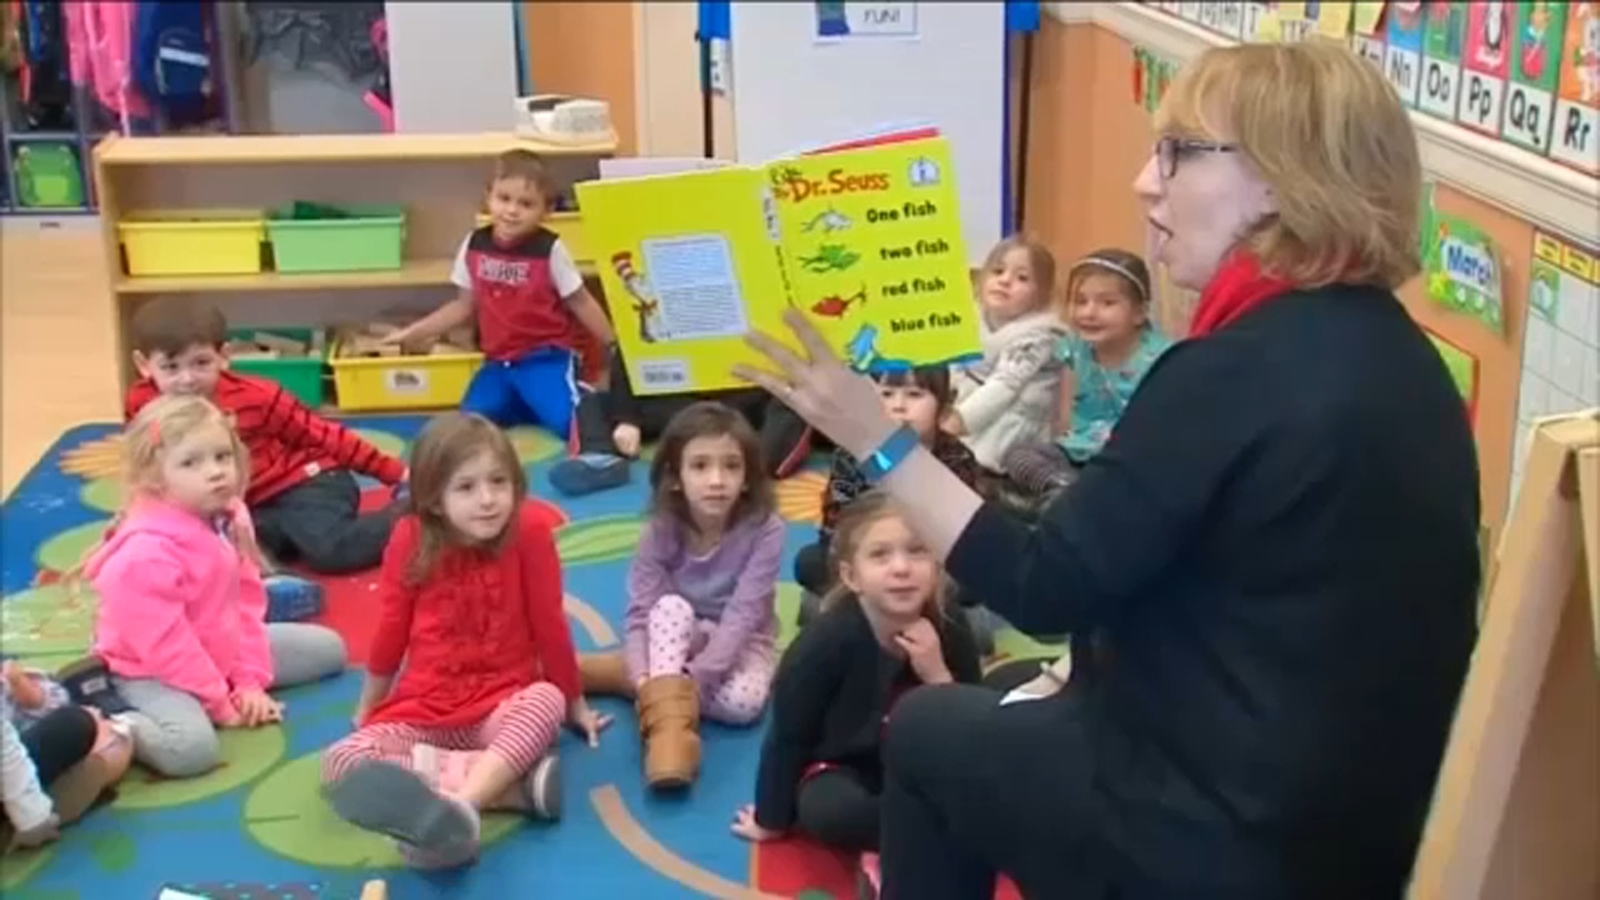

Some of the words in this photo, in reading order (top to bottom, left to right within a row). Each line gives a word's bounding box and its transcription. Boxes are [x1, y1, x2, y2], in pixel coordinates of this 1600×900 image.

[1427, 63, 1450, 101] Oo
[1469, 76, 1491, 123] Pp
[1509, 89, 1541, 145] Qq
[1564, 106, 1591, 151] Rr
[787, 177, 827, 202] Dr.
[828, 169, 891, 194] Seuss
[866, 208, 899, 223] One
[903, 201, 937, 218] fish
[880, 247, 912, 260] two
[916, 238, 949, 256] fish
[882, 281, 908, 297] red
[912, 277, 946, 293] fish
[890, 319, 925, 333] blue
[929, 312, 961, 327] fish
